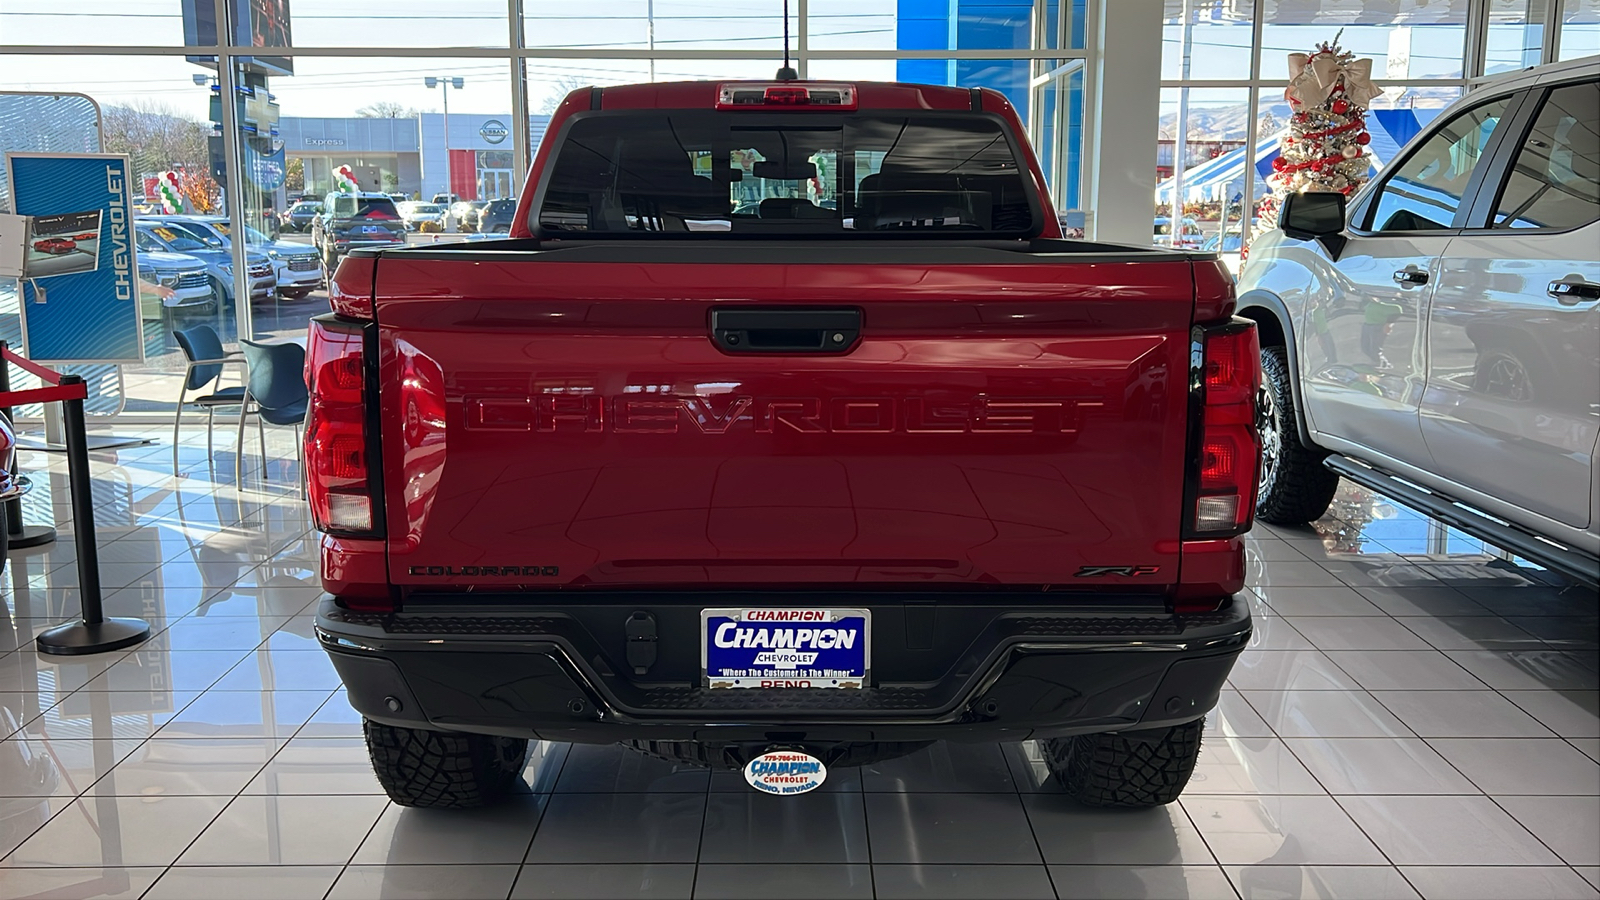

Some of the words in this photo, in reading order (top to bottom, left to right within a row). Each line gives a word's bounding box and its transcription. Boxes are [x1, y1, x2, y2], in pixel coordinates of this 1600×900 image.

[305, 137, 344, 146] Express
[106, 165, 130, 300] CHEVROLET
[463, 395, 1104, 433] CHEVROLET
[408, 565, 560, 577] COLORADO
[747, 611, 826, 621] CHAMPION
[714, 622, 858, 649] CHAMPION
[758, 654, 814, 663] CHEVROLET
[748, 669, 762, 677] The
[763, 669, 799, 677] Customer
[800, 669, 807, 677] Is
[809, 669, 822, 677] The
[761, 680, 811, 688] RENO
[751, 760, 821, 775] CHAMPION
[753, 780, 780, 793] RENO,
[782, 780, 818, 793] NEVADA
